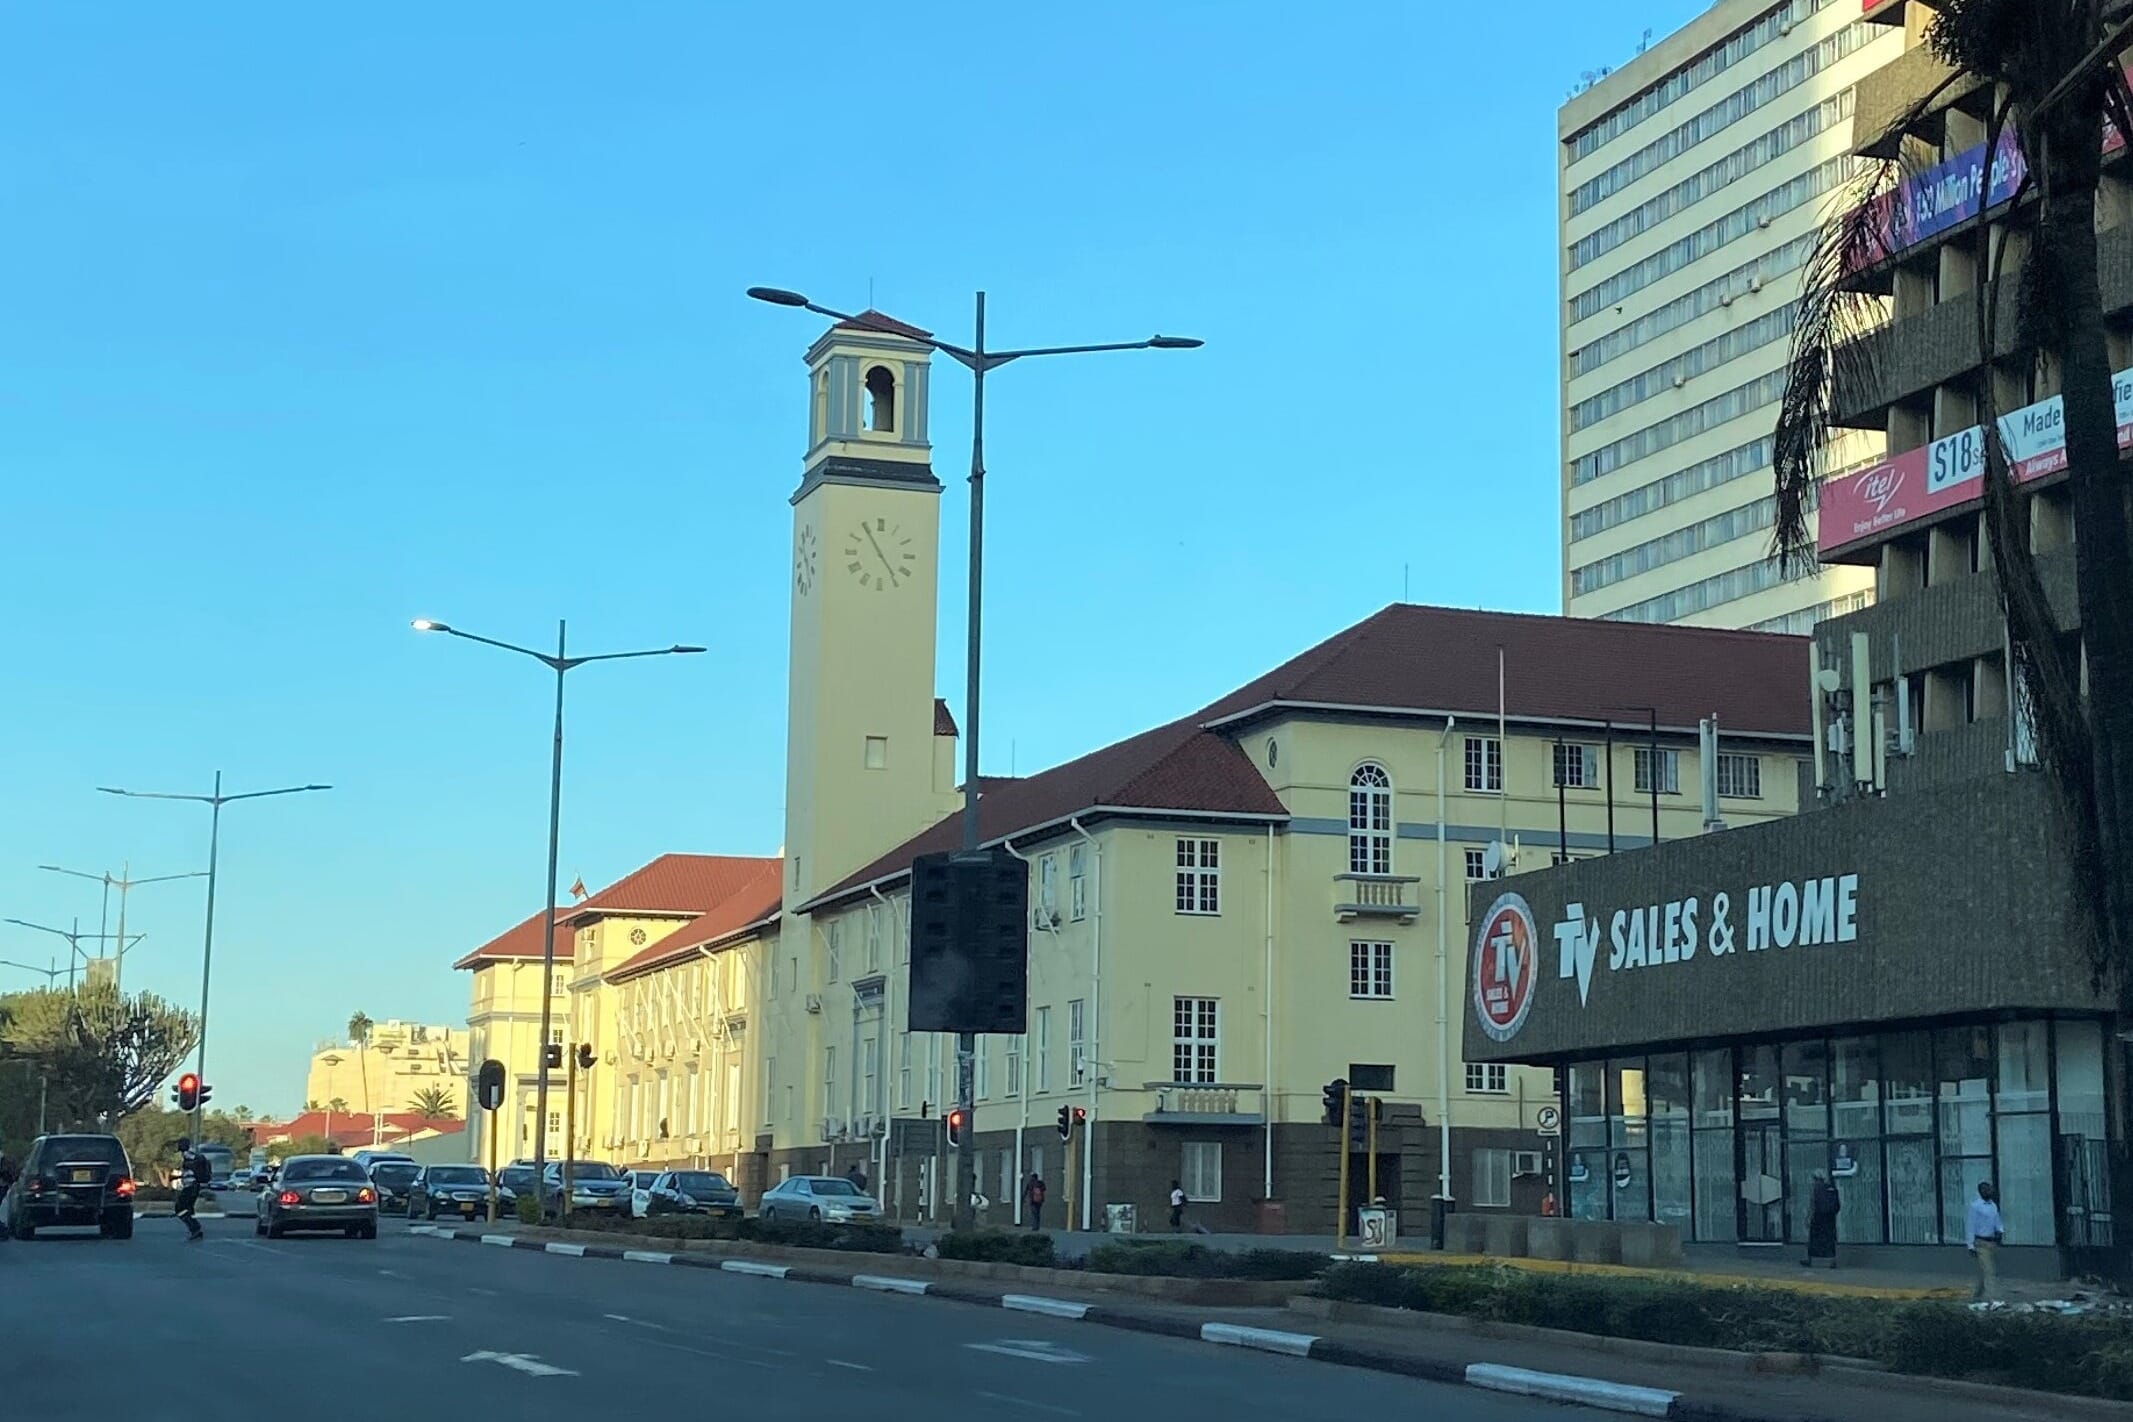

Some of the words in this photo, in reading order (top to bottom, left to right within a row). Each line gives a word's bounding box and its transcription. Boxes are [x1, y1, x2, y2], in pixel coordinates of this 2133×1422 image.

[1969, 149, 2009, 198] Peple
[2024, 404, 2061, 438] Made
[1935, 431, 1972, 482] S18
[1864, 468, 1896, 499] itel
[1490, 920, 1527, 1000] TV
[1554, 902, 1600, 1010] TV
[1609, 896, 1698, 971] SALES
[1708, 891, 1736, 956] &
[1747, 873, 1858, 952] HOME
